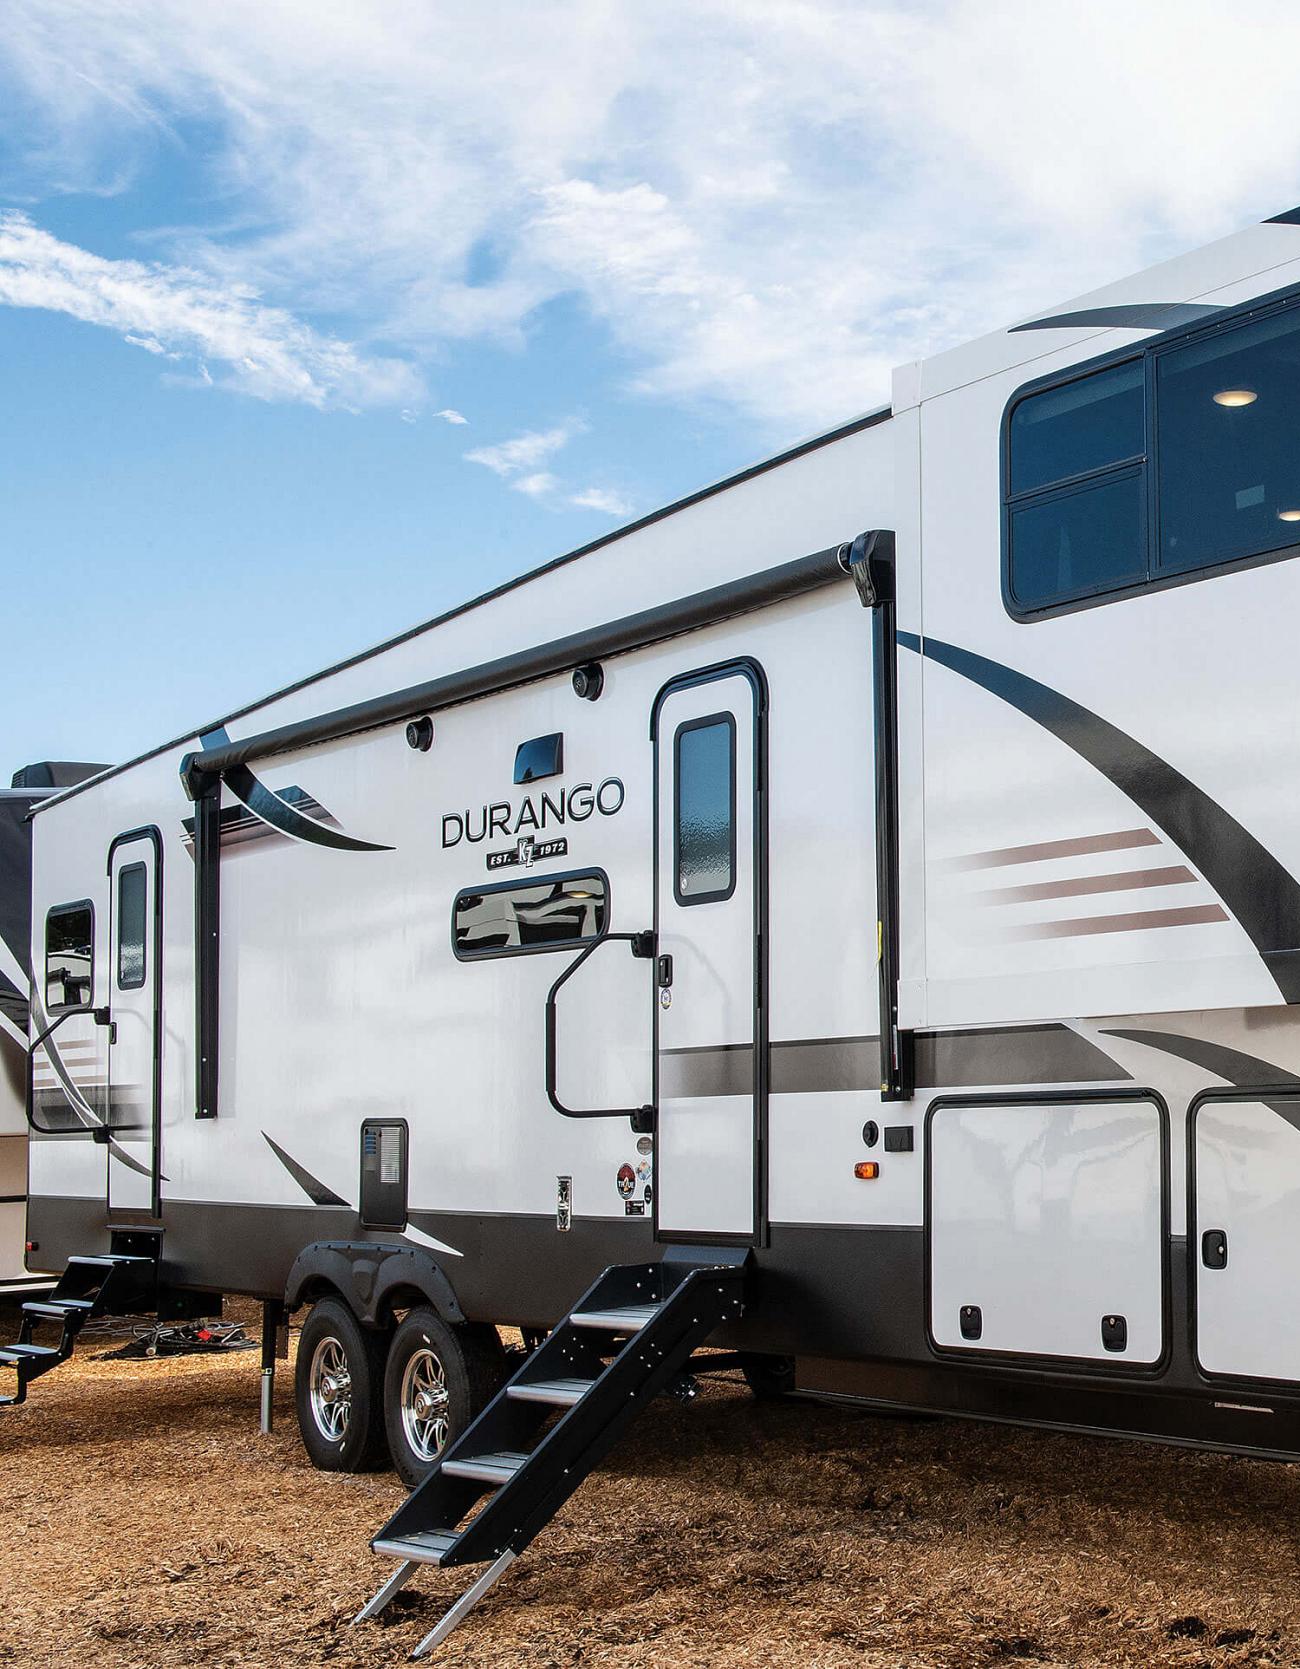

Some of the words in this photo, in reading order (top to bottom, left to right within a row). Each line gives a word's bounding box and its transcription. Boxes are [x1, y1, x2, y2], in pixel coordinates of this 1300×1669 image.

[442, 776, 625, 848] DURANGO
[490, 854, 511, 866] EST.
[540, 841, 565, 856] 1972
